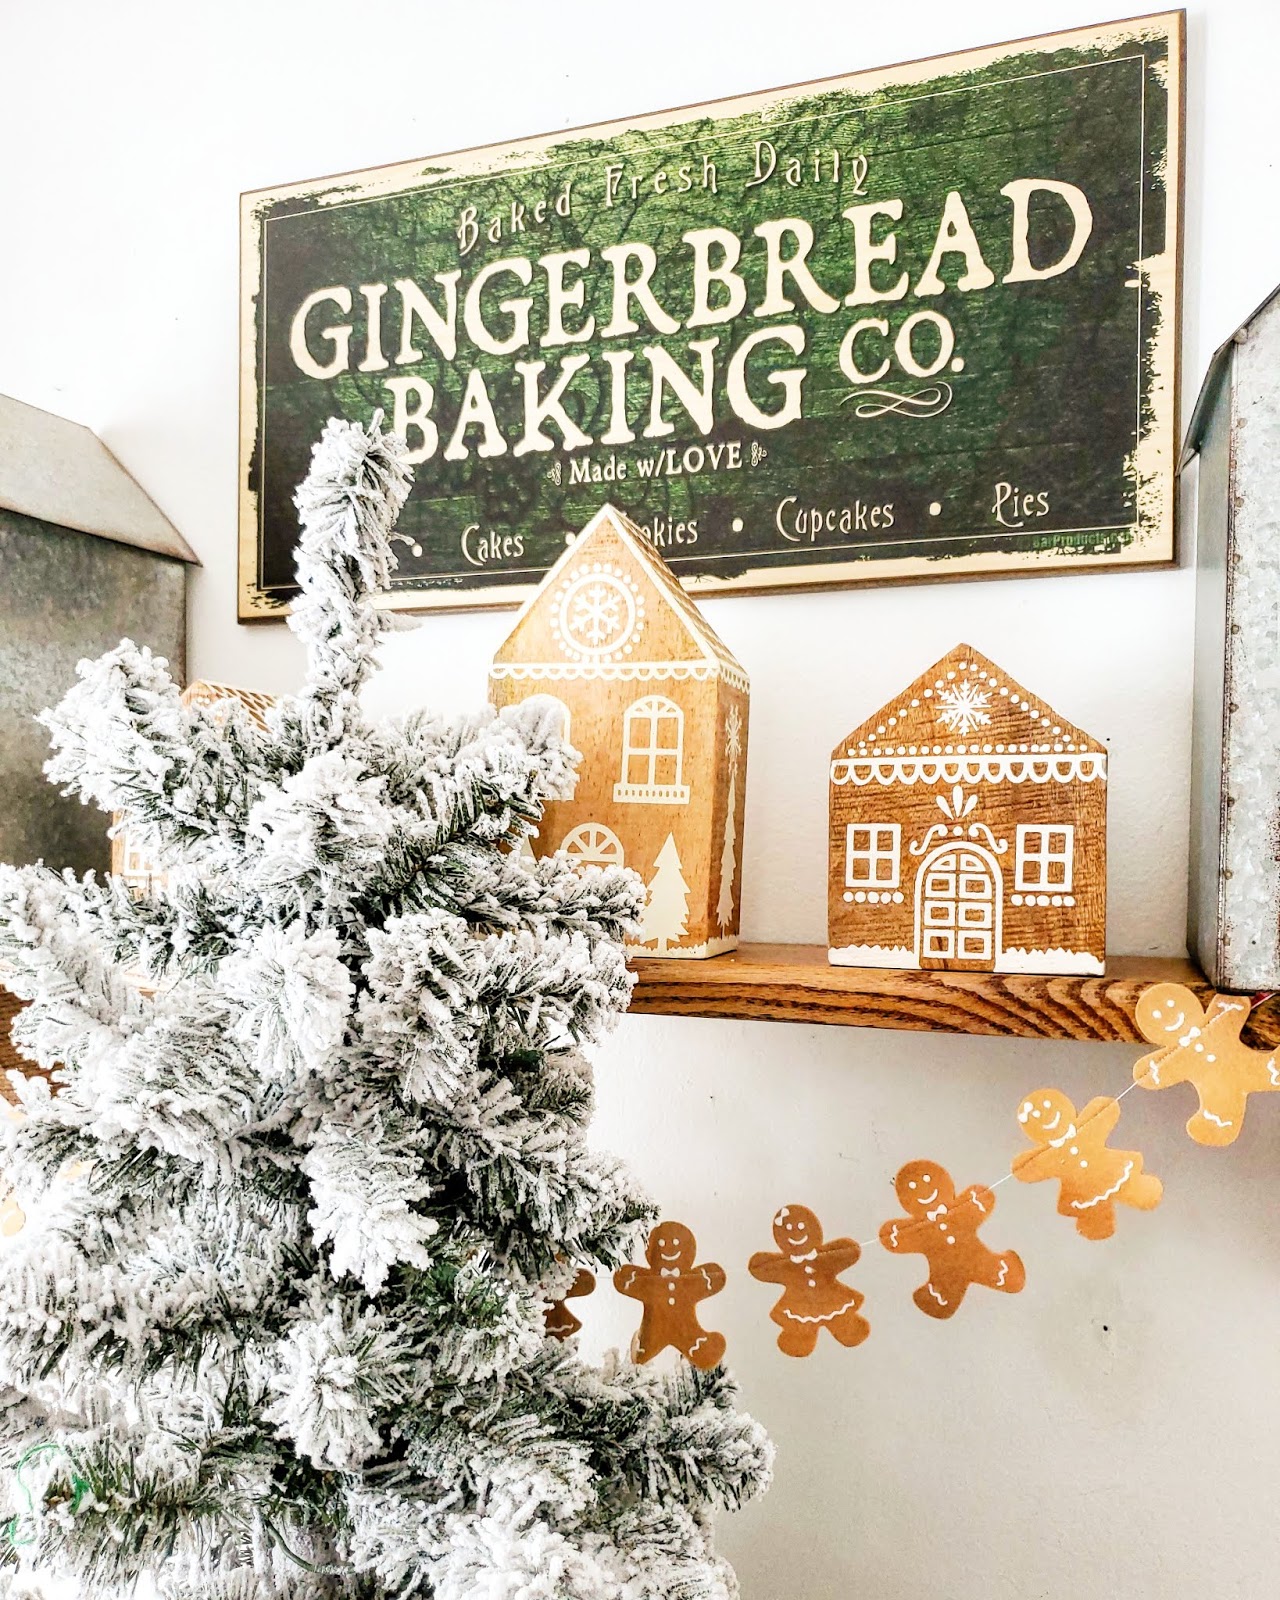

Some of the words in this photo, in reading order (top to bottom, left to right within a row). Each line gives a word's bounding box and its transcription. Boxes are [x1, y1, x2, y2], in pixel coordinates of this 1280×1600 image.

[457, 183, 572, 256] Baked
[605, 155, 718, 207] Fresh
[745, 141, 868, 196] Daily
[289, 177, 1094, 381] GINGERBREAD
[384, 324, 808, 466] BAKING
[837, 309, 965, 385] CO.
[568, 453, 627, 485] Made
[636, 441, 743, 478] w/LOVE
[461, 523, 525, 566] Cakes
[636, 513, 698, 548] okies
[776, 495, 895, 542] Cupcakes
[992, 481, 1050, 528] Pies
